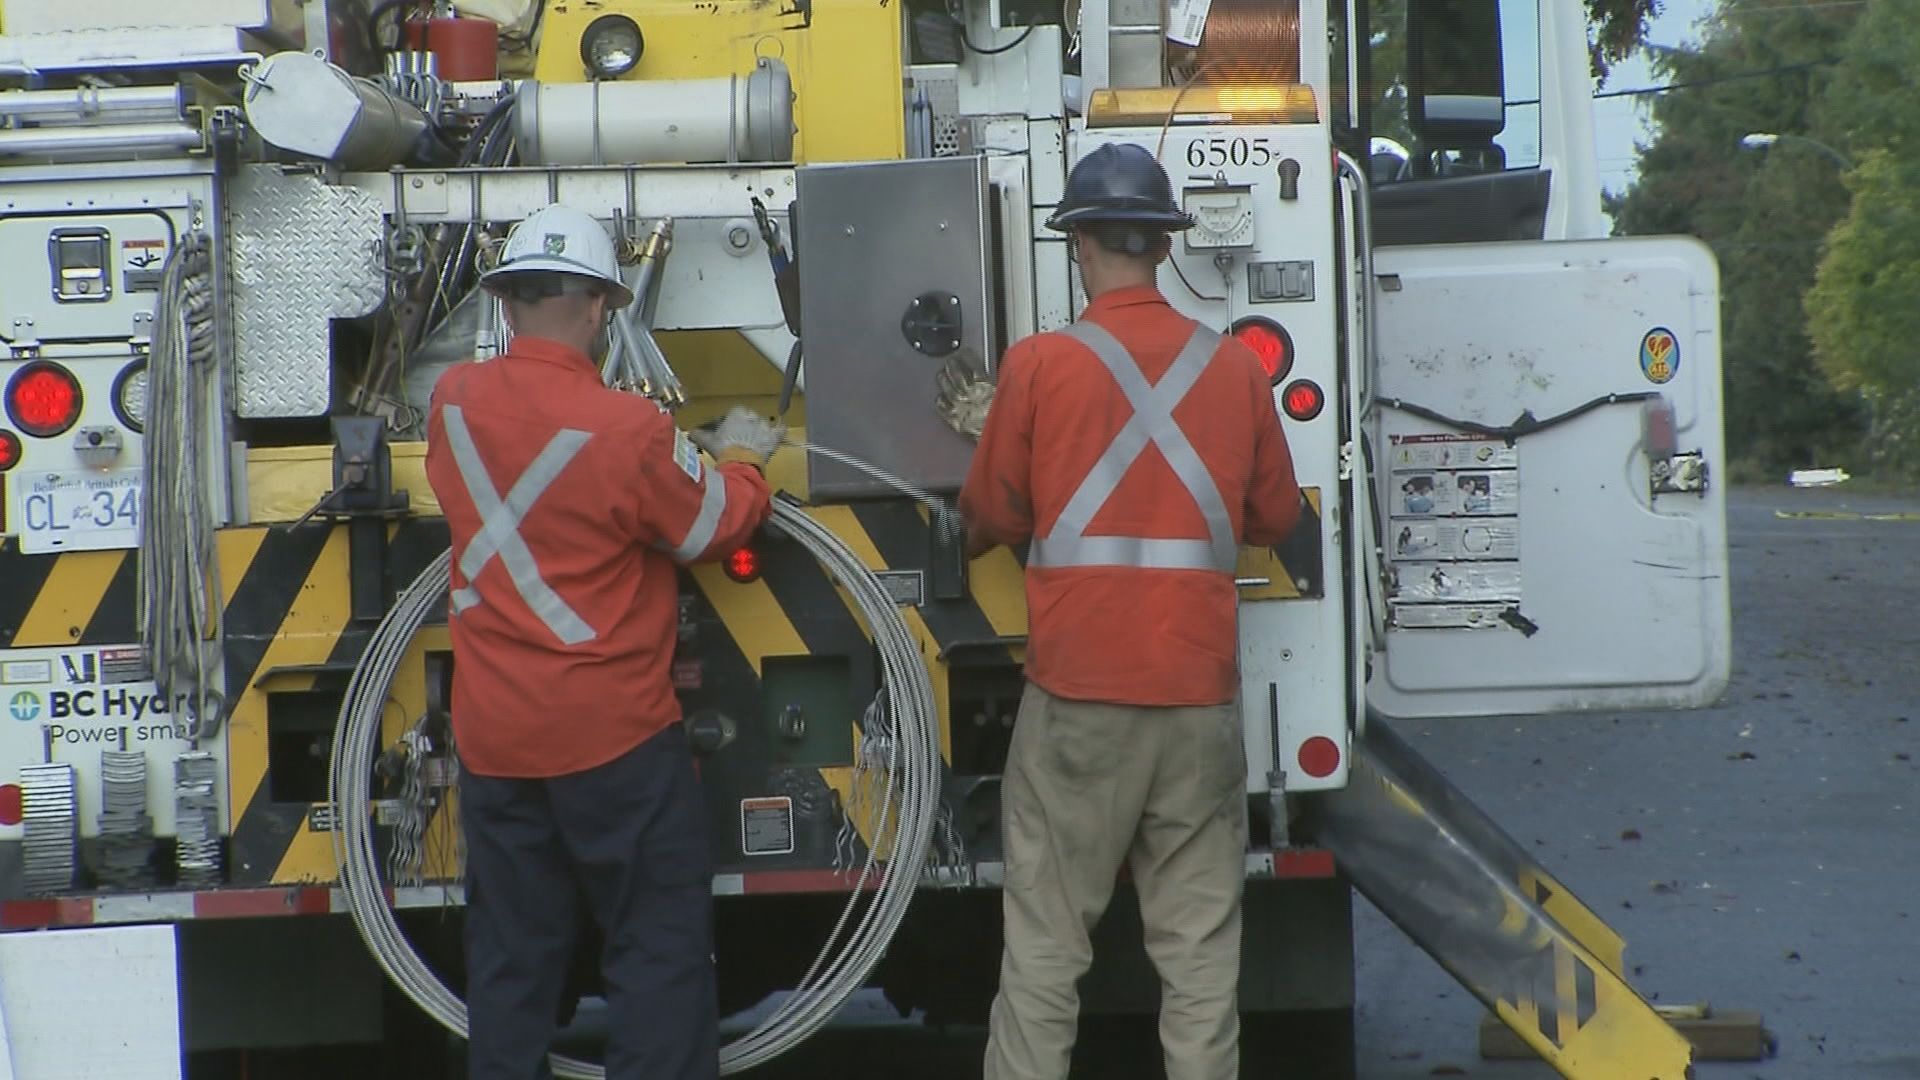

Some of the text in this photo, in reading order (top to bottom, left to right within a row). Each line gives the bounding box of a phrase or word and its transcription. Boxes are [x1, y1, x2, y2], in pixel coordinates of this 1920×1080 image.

[1186, 138, 1270, 167] 6505
[26, 494, 70, 530] CL
[50, 689, 206, 720] BC Hydr
[52, 723, 192, 744] Powe sma
